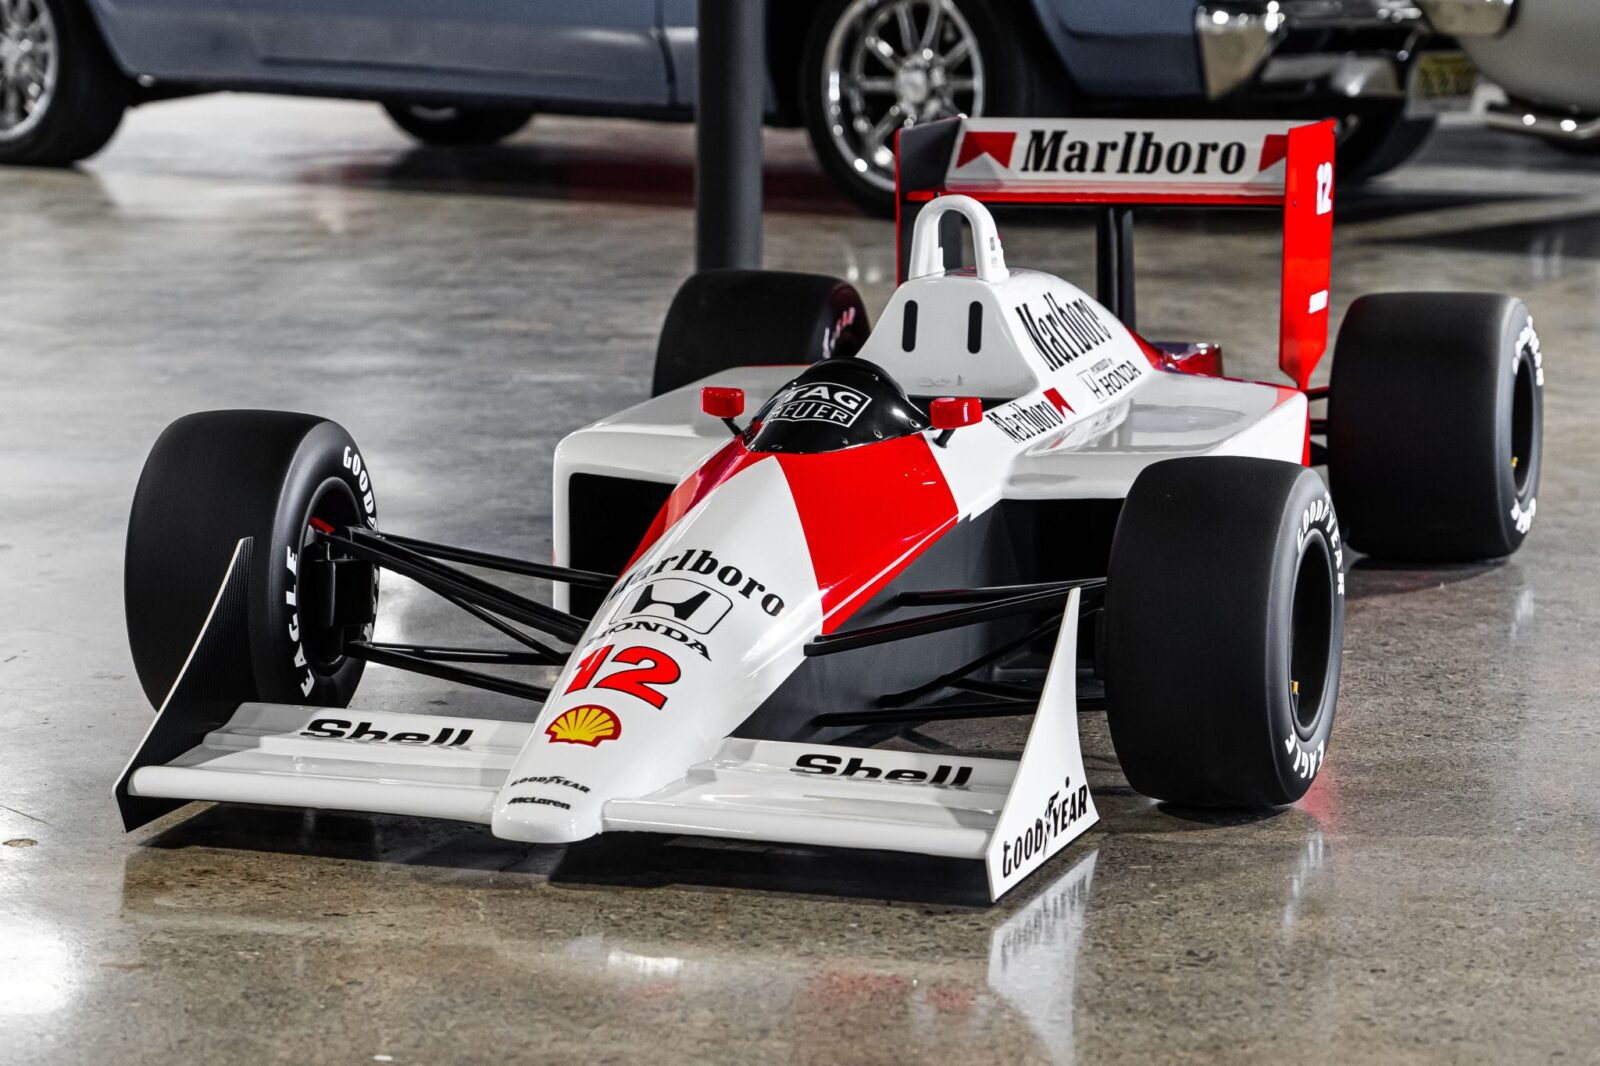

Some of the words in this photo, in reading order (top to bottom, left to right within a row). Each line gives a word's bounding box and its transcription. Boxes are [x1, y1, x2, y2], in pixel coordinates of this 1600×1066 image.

[1020, 130, 1247, 174] Marlboro
[784, 386, 863, 410] TAG
[1099, 359, 1142, 397] HONDA
[985, 401, 1064, 445] Marlboro
[286, 545, 315, 698] EAGLE
[563, 643, 682, 711] 12
[300, 718, 474, 747] Shell
[789, 753, 974, 787] Shell
[1002, 783, 1089, 879] GOODYEAR
